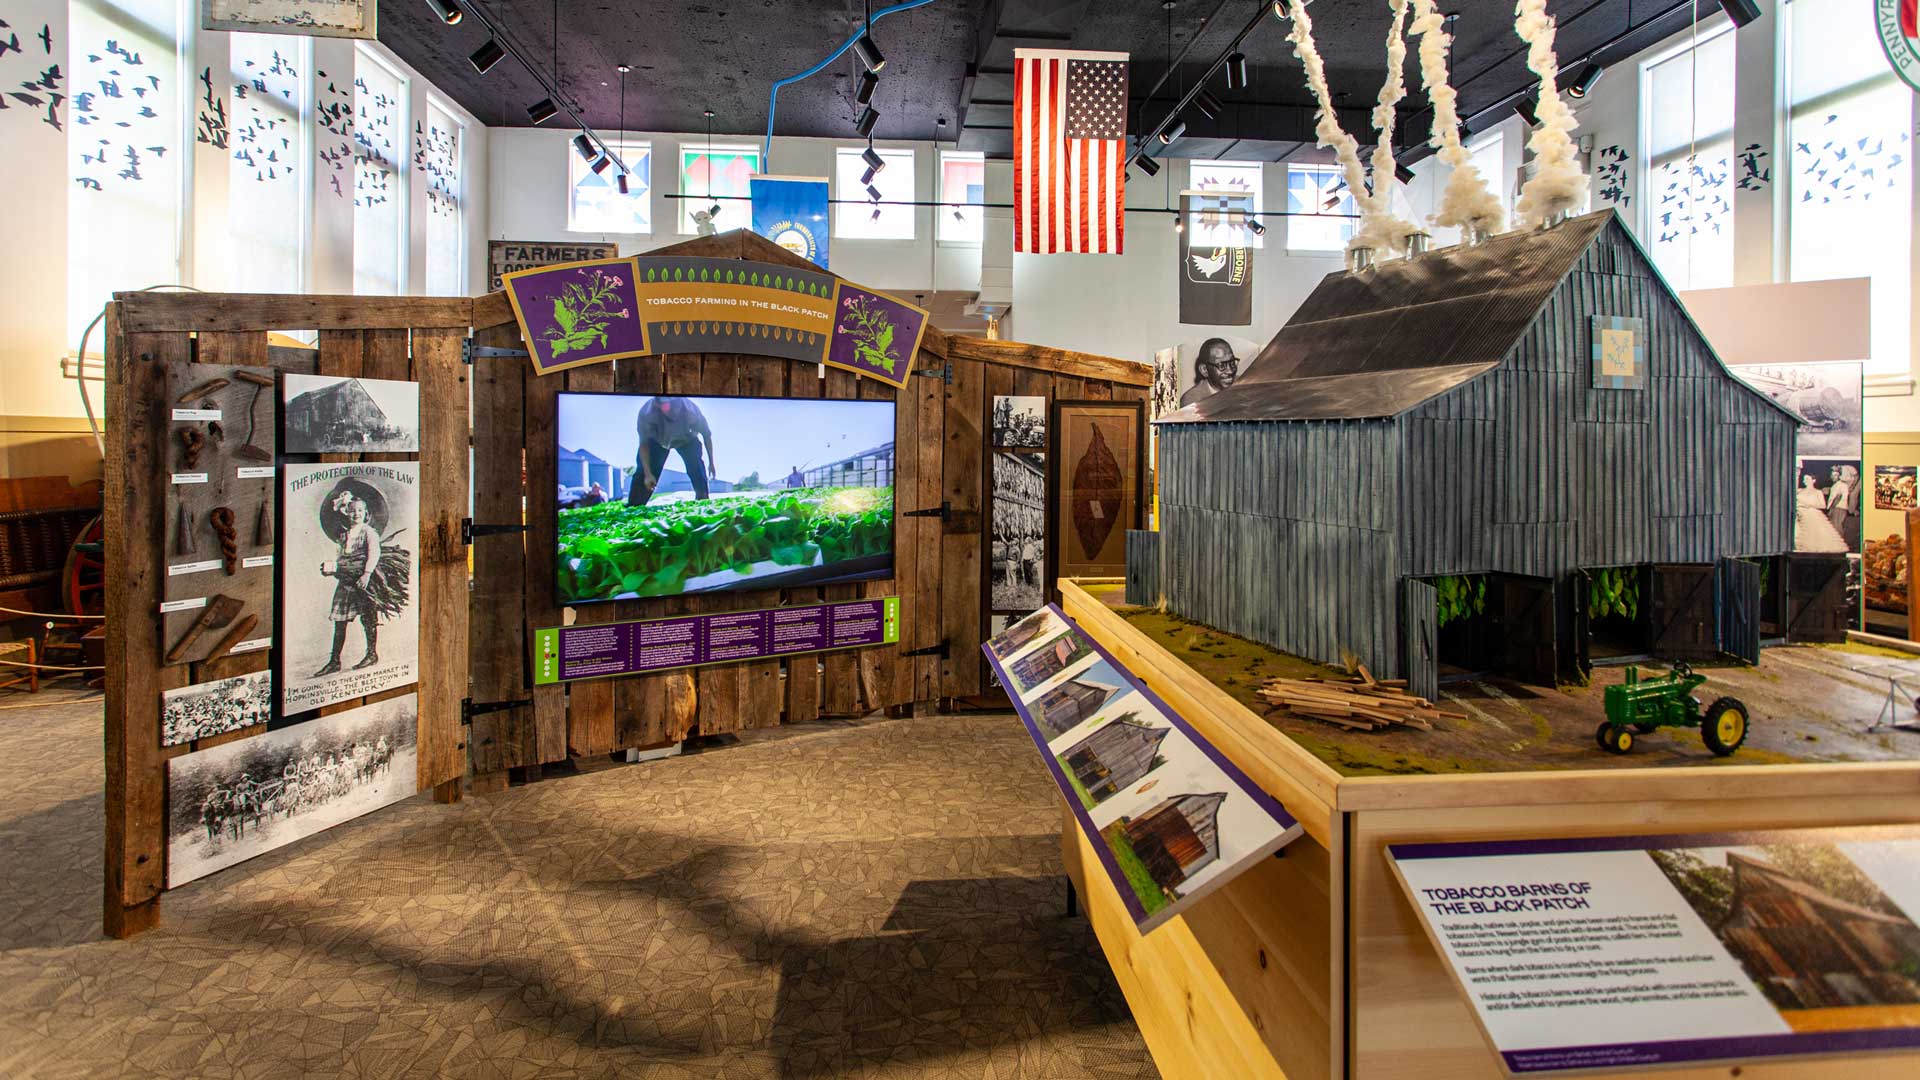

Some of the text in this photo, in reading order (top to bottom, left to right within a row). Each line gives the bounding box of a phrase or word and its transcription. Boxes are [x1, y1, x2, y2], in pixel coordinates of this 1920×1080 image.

[505, 247, 608, 261] FARMERS
[646, 297, 693, 305] TOBACCO
[695, 297, 737, 306] FARMING
[751, 300, 769, 309] THE
[770, 302, 800, 314] BLACK
[801, 308, 829, 320] PATCH
[290, 465, 414, 492] THE PROTECTION OF THE LAW
[301, 684, 324, 693] GOING
[354, 672, 371, 681] OPEN
[373, 666, 398, 677] MARKET
[344, 682, 358, 690] THE
[361, 677, 377, 686] BEST
[379, 674, 399, 682] TOWN
[310, 697, 326, 705] OLD
[1422, 882, 1592, 901] TOBACCO BARNS OF
[1430, 896, 1591, 916] THE BLACK PATCH
